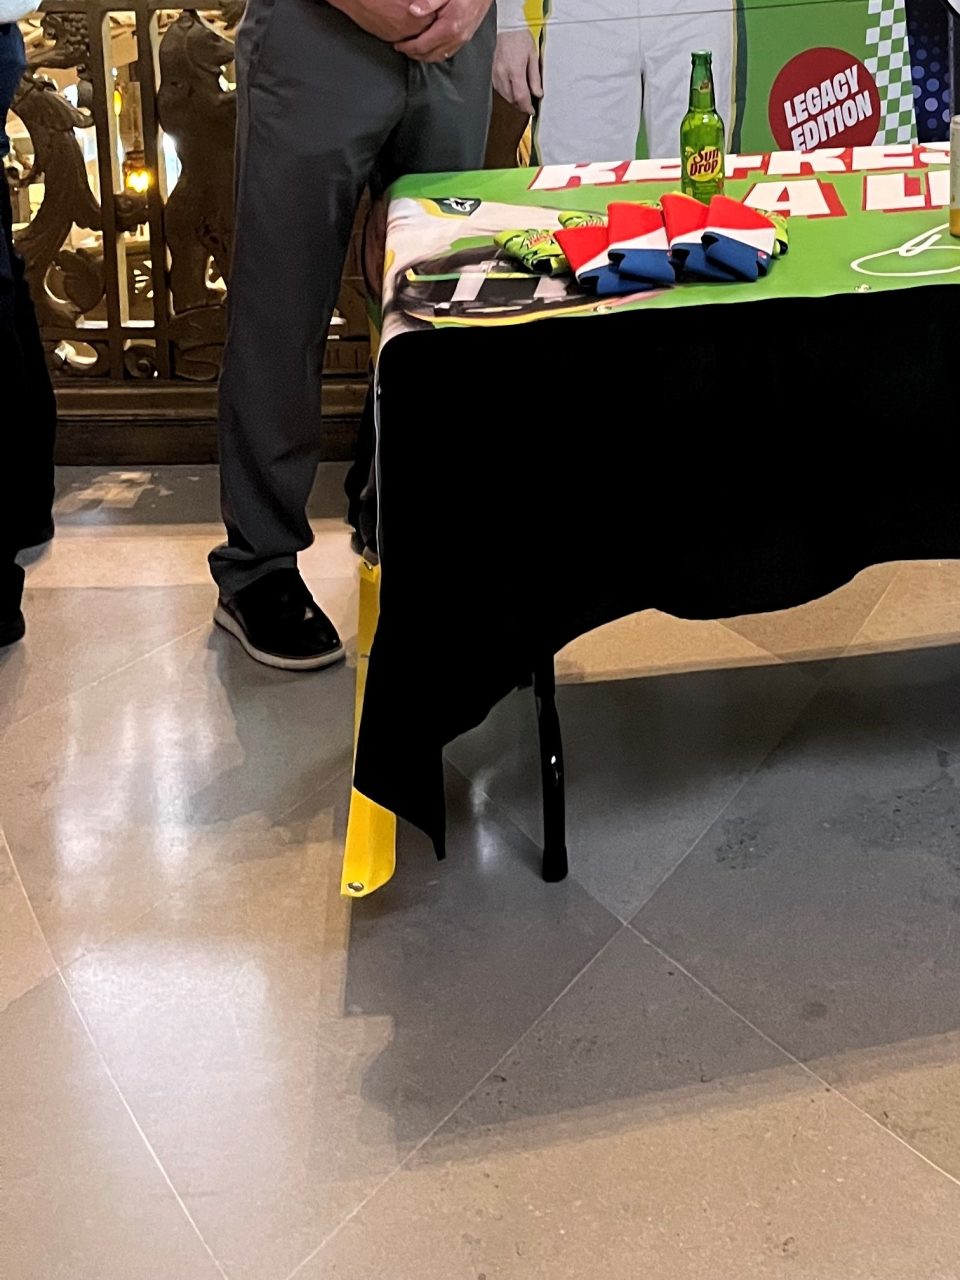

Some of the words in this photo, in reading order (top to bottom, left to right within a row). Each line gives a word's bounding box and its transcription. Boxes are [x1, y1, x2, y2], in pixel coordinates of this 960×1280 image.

[783, 64, 859, 129] LEGACY
[790, 90, 873, 153] EDITION
[690, 159, 719, 177] Drop
[693, 147, 719, 163] Sun
